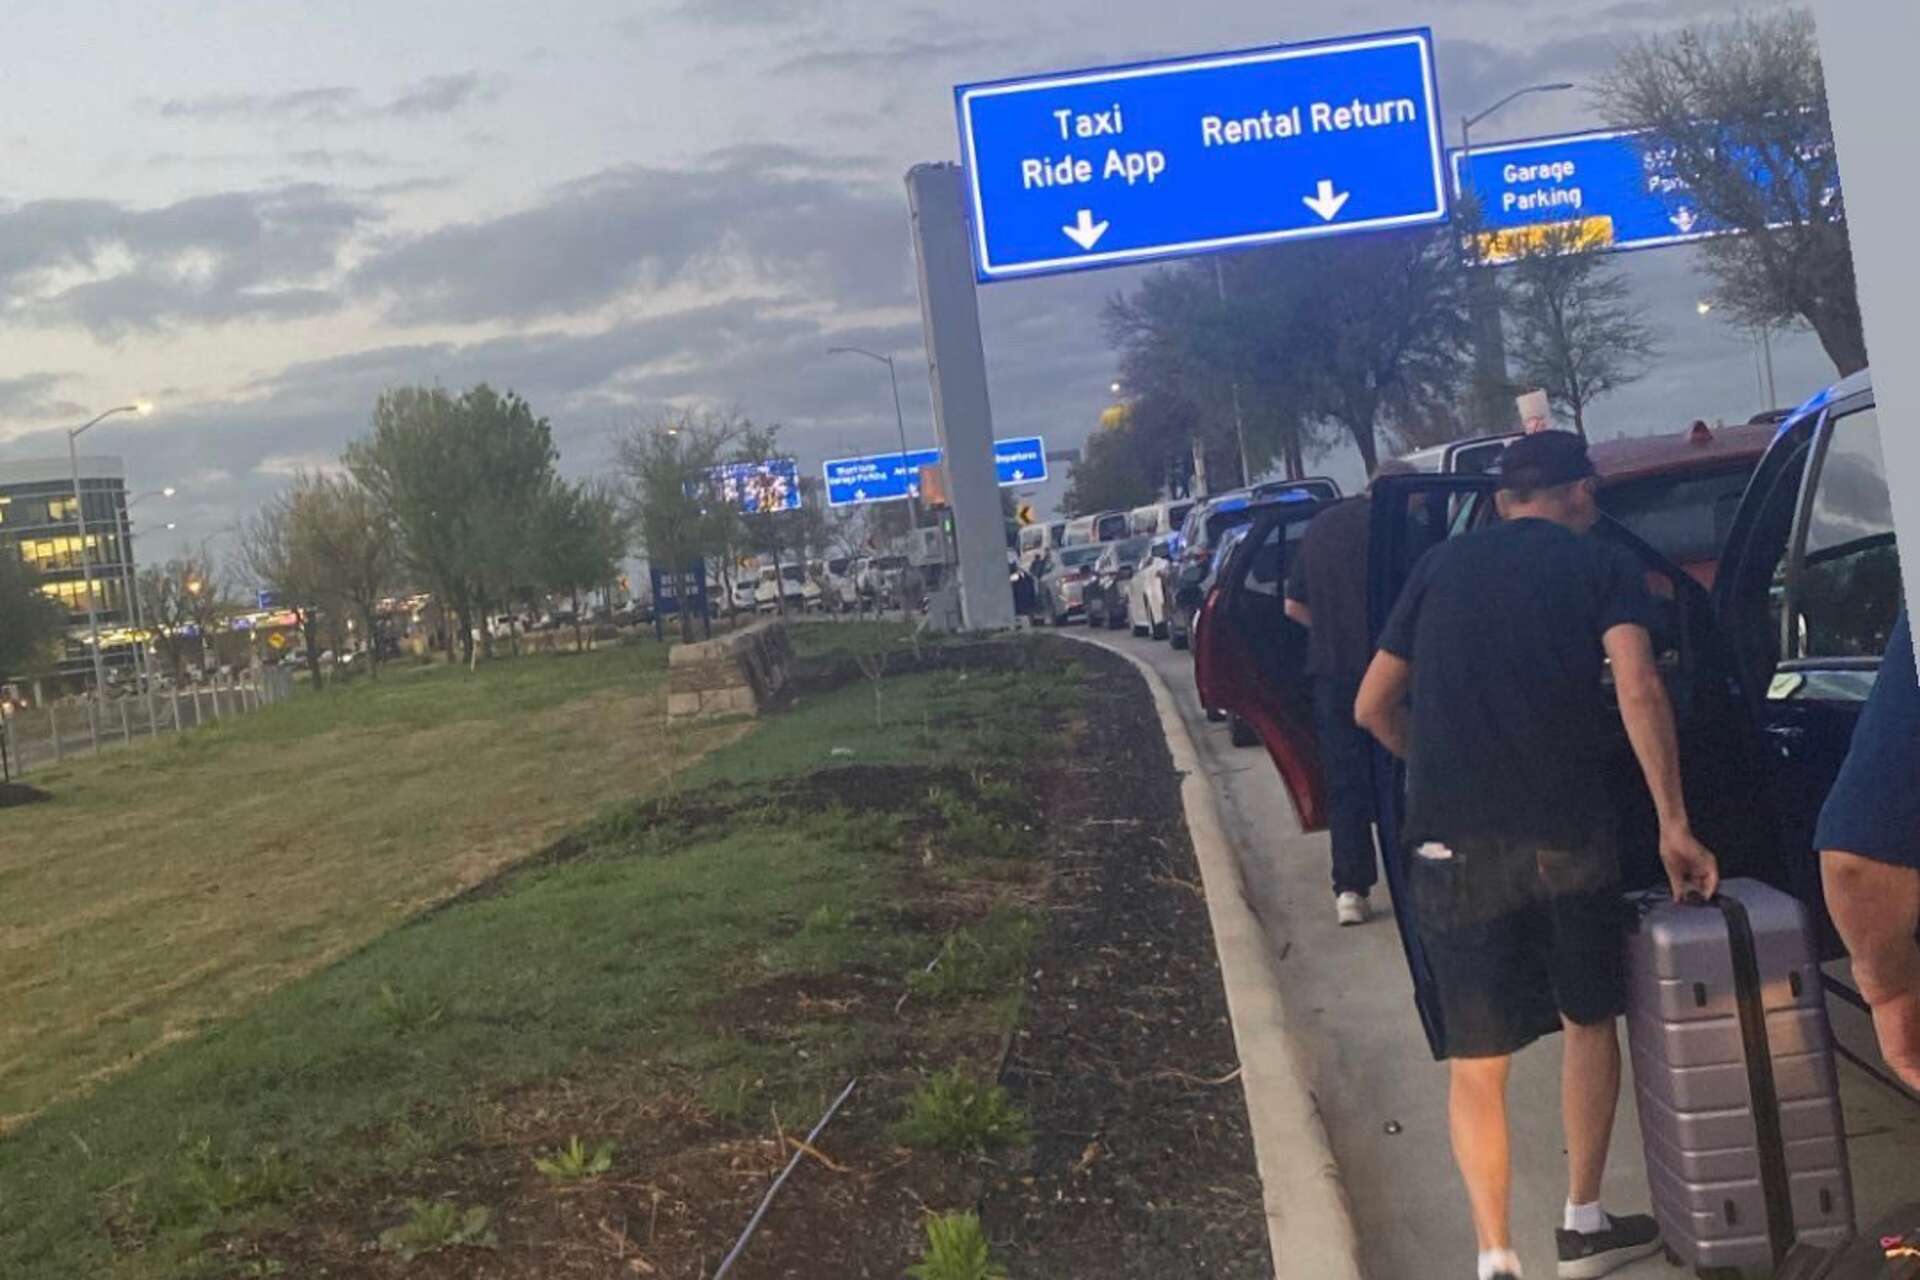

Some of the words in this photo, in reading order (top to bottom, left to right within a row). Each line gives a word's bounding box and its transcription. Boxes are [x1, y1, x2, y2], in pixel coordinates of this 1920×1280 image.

[1053, 103, 1123, 140] Taxi
[1201, 106, 1302, 146] Rental
[1310, 97, 1417, 132] Return
[1021, 155, 1093, 189] Ride
[1103, 149, 1166, 185] App
[1502, 159, 1576, 184] Garage
[1501, 186, 1583, 213] Parking
